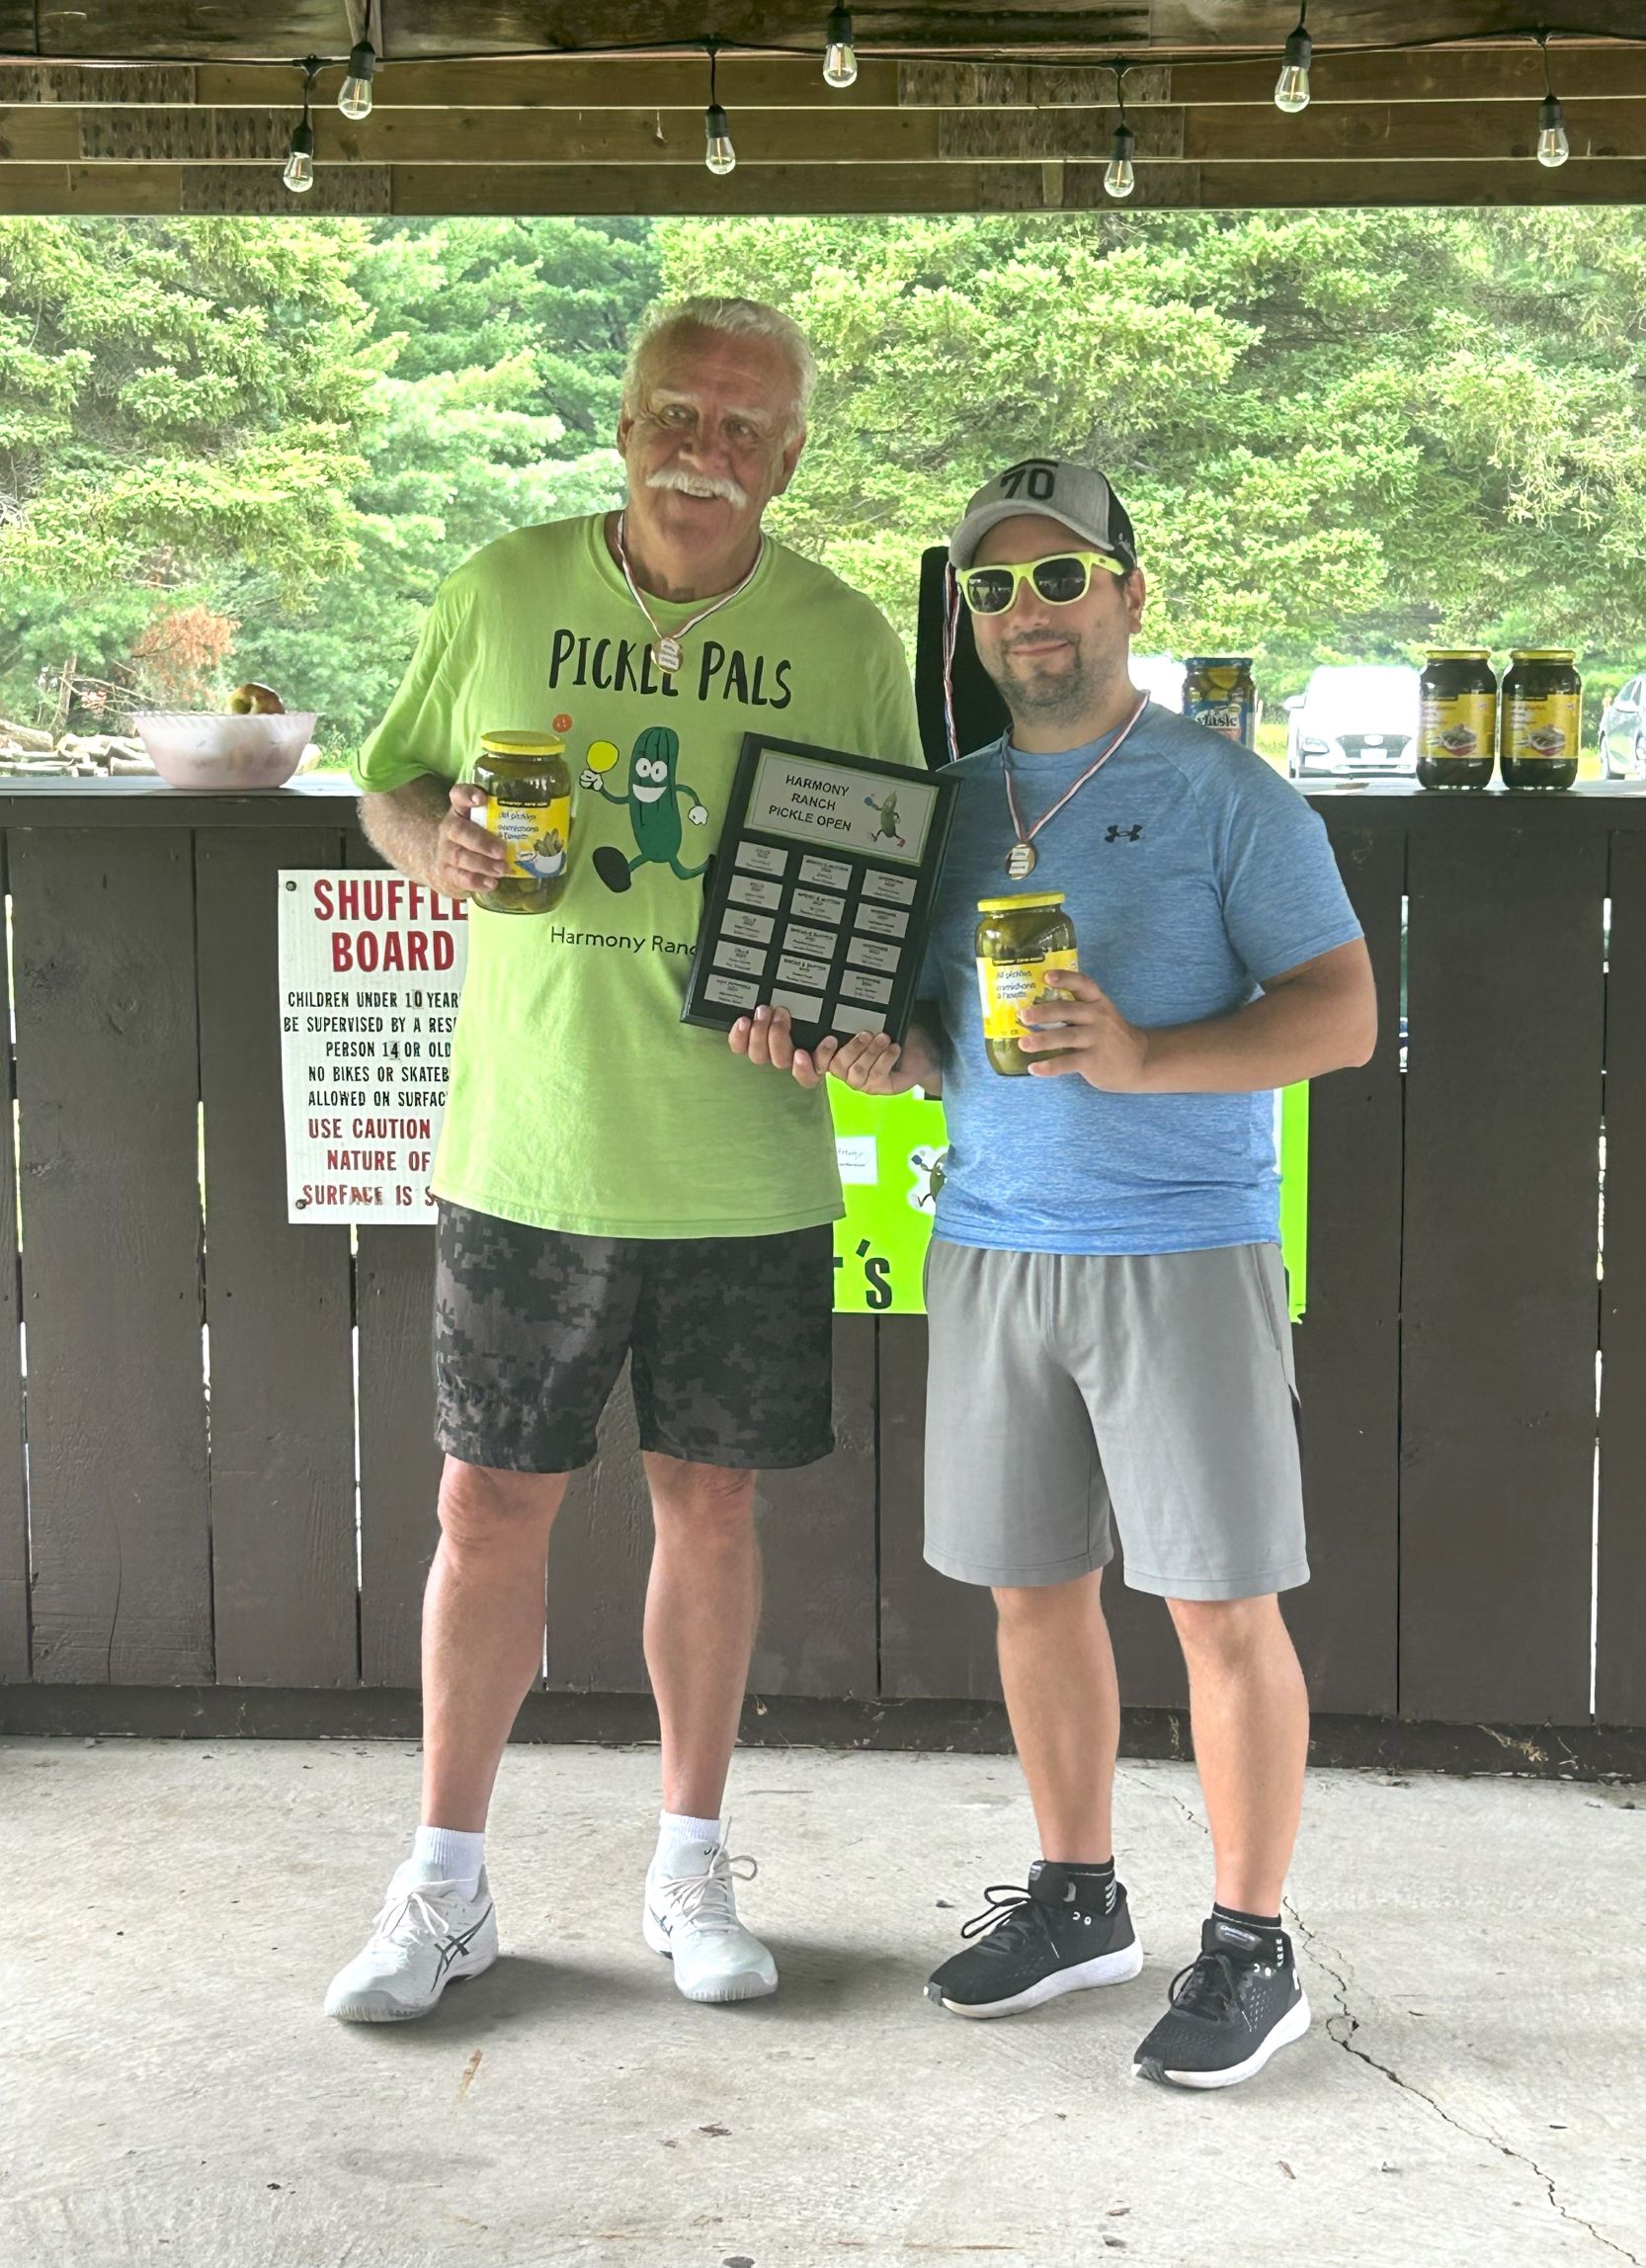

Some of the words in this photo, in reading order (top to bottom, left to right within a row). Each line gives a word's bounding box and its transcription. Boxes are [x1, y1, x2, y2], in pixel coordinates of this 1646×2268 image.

[1000, 466, 1056, 500] 70
[699, 640, 791, 709] PALS
[785, 774, 850, 797] HARMONY
[791, 793, 836, 810] RANCH
[769, 804, 814, 823] PICKLE
[817, 815, 852, 831] OPEN
[332, 930, 454, 972] BOARD
[550, 926, 645, 954] Harmony
[288, 991, 349, 1008] CHILDREN
[357, 991, 397, 1008] UNDER
[405, 990, 423, 1008] 10
[427, 991, 461, 1008] YEAR
[284, 1016, 299, 1033] BE
[306, 1016, 383, 1033] SUPERVISED
[391, 1016, 406, 1033] BY
[413, 1016, 421, 1033] A
[326, 1041, 374, 1057] PERSON
[382, 1041, 399, 1058] 14
[404, 1041, 421, 1057] OR
[308, 1065, 325, 1082] NO
[333, 1065, 370, 1082] BIKES
[377, 1066, 393, 1082] OR
[308, 1090, 366, 1106] ALLOWED
[373, 1091, 390, 1107] ON
[398, 1091, 449, 1107] SURFAC
[308, 1118, 343, 1138] USE
[352, 1118, 431, 1139] CAUTION
[327, 1149, 397, 1171] NATURE
[408, 1150, 431, 1172] OF
[302, 1184, 383, 1206] SURFACE
[396, 1185, 412, 1206] IS
